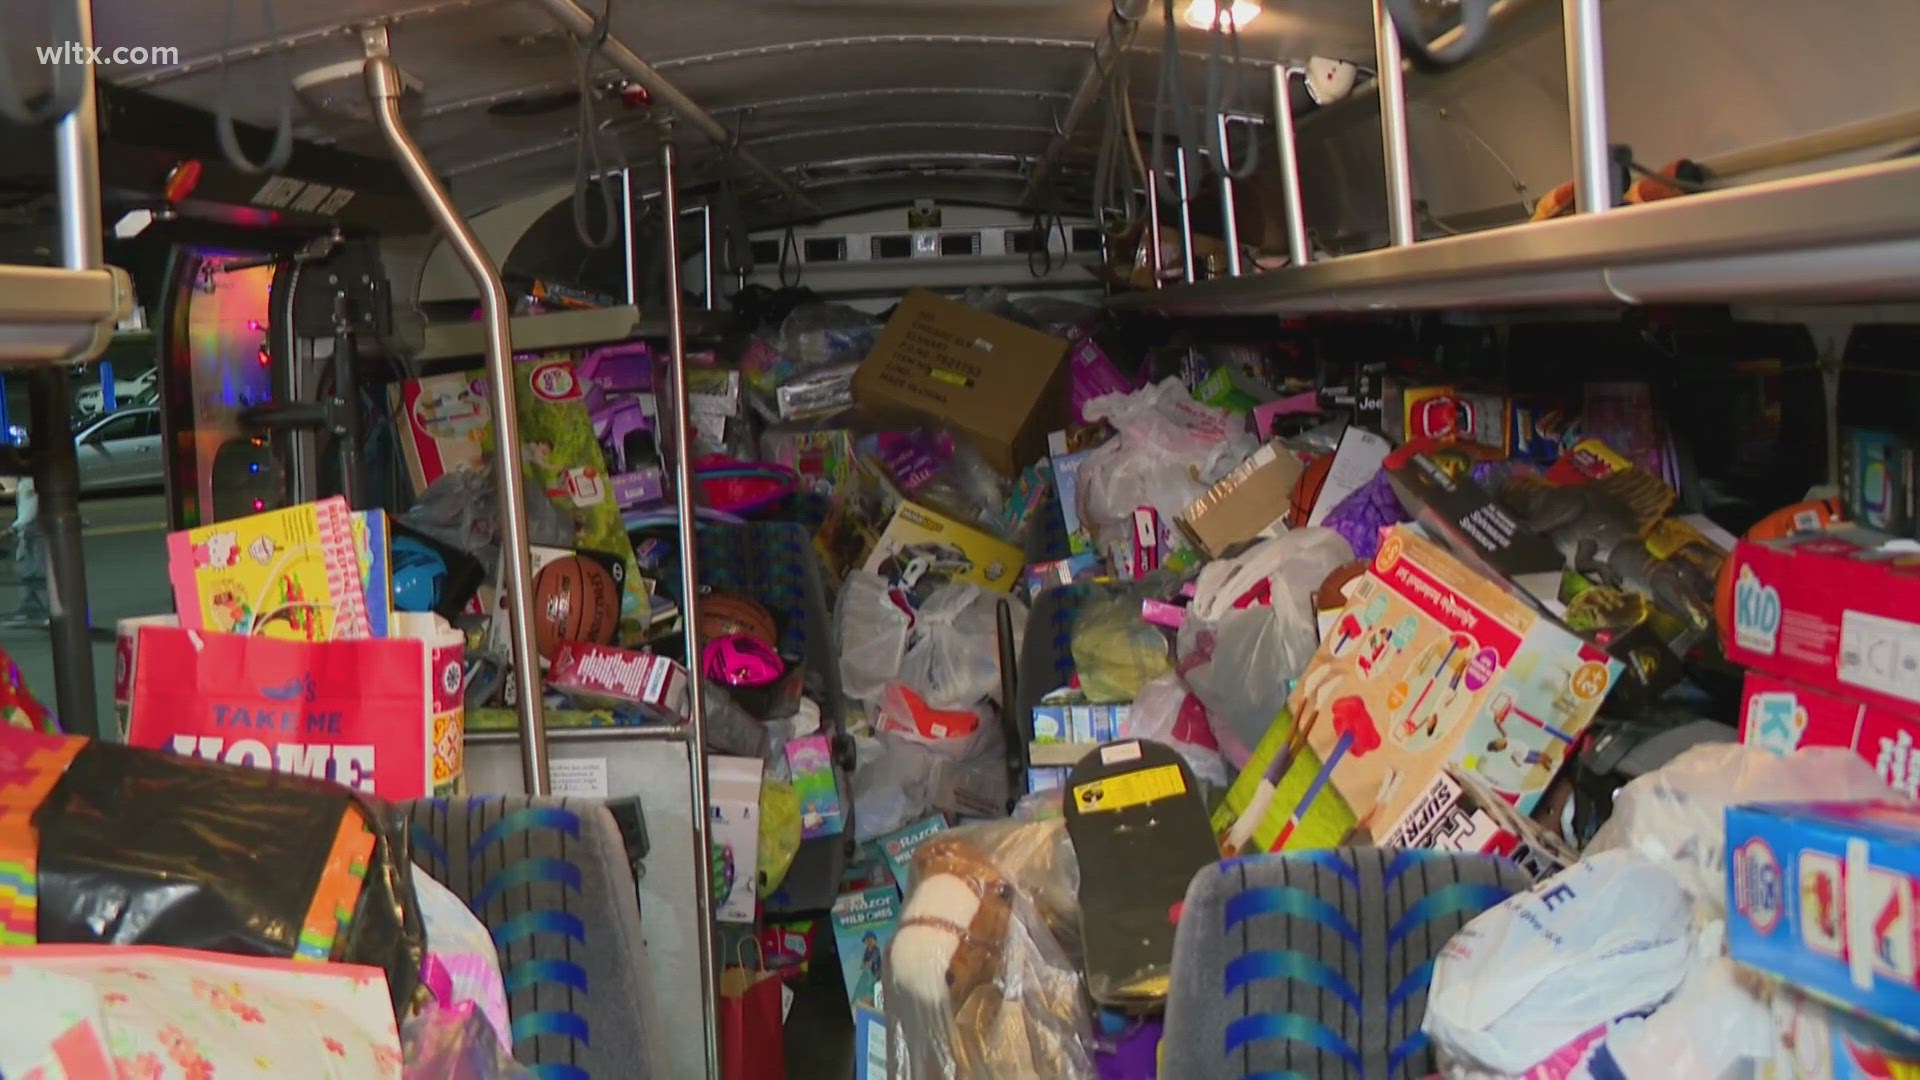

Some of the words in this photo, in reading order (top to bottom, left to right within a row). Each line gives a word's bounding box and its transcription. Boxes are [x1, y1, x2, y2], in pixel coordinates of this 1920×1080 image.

[328, 504, 345, 545] HELLO
[1735, 583, 1778, 634] KID
[213, 705, 298, 731] TAKE
[306, 713, 343, 733] ME
[899, 824, 941, 851] Razor
[838, 911, 866, 927] WILD
